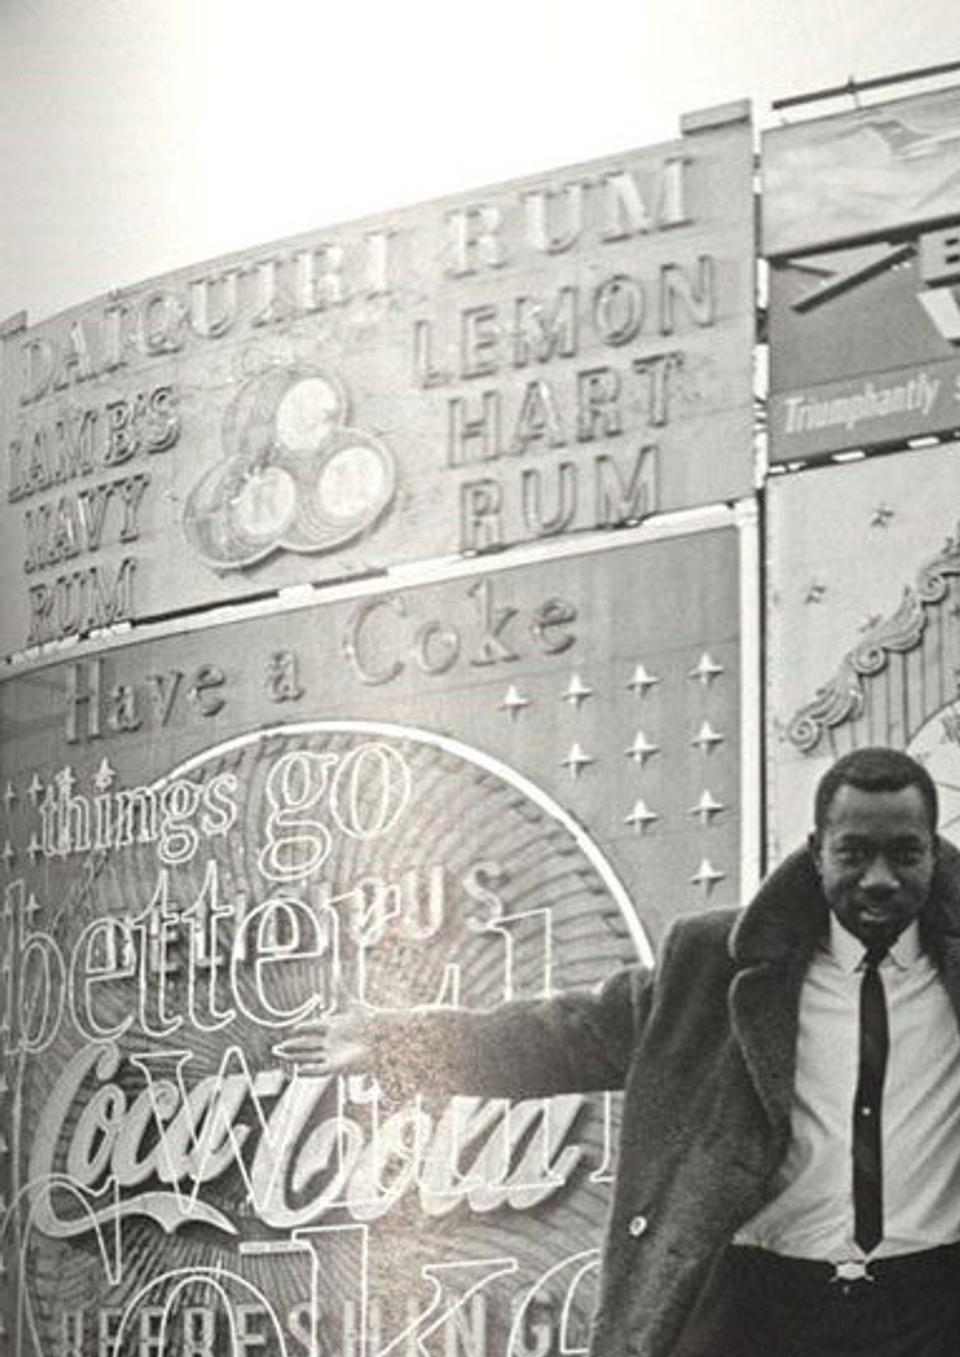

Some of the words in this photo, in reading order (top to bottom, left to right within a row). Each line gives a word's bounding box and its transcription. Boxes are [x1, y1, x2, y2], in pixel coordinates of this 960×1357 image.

[20, 230, 399, 408] DAIQUIRI
[444, 155, 695, 282] RUM
[413, 254, 716, 392] LEMON
[6, 385, 182, 505] LAMB'S
[446, 350, 686, 470] HART
[784, 371, 941, 434] Triumphantly
[24, 472, 150, 574] NAVY
[458, 444, 663, 557] RUM
[27, 556, 138, 648] RUM
[64, 655, 226, 746] Have
[265, 650, 305, 702] a
[343, 578, 578, 687] Coke
[39, 757, 238, 864] things
[258, 742, 412, 882] go
[27, 1038, 585, 1238] Coca-Cola
